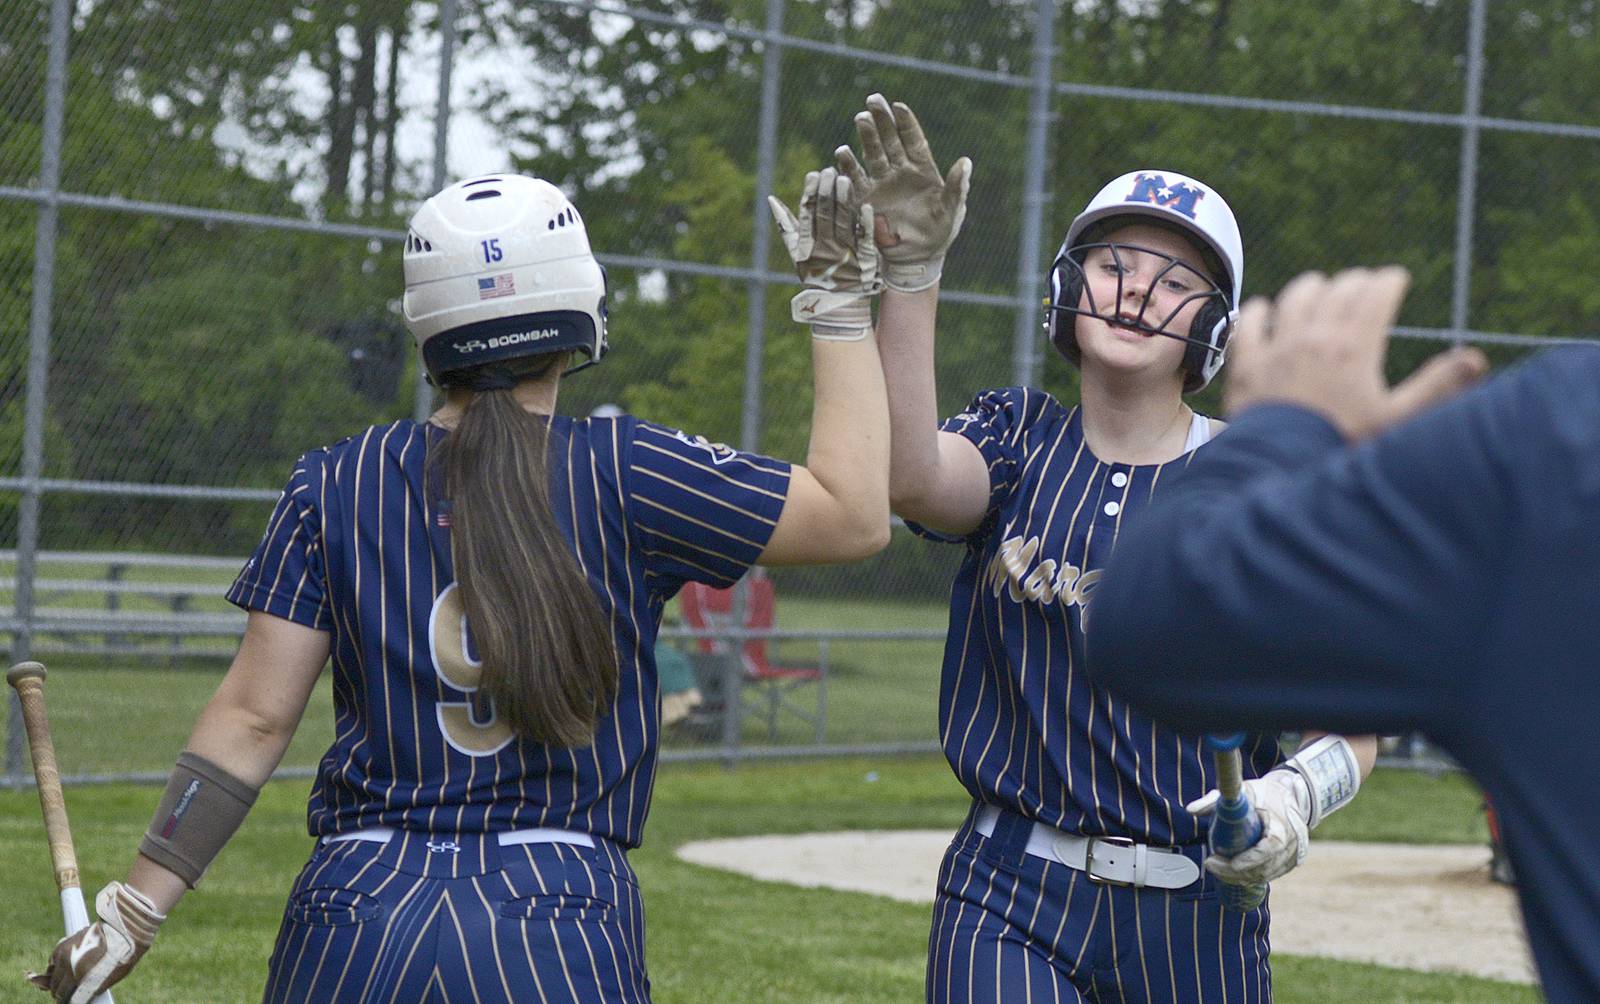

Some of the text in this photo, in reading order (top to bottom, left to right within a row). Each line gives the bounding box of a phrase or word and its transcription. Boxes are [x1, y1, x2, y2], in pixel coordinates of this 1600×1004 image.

[1124, 173, 1205, 220] M
[481, 238, 503, 263] 15
[488, 328, 559, 348] BOOMBAH
